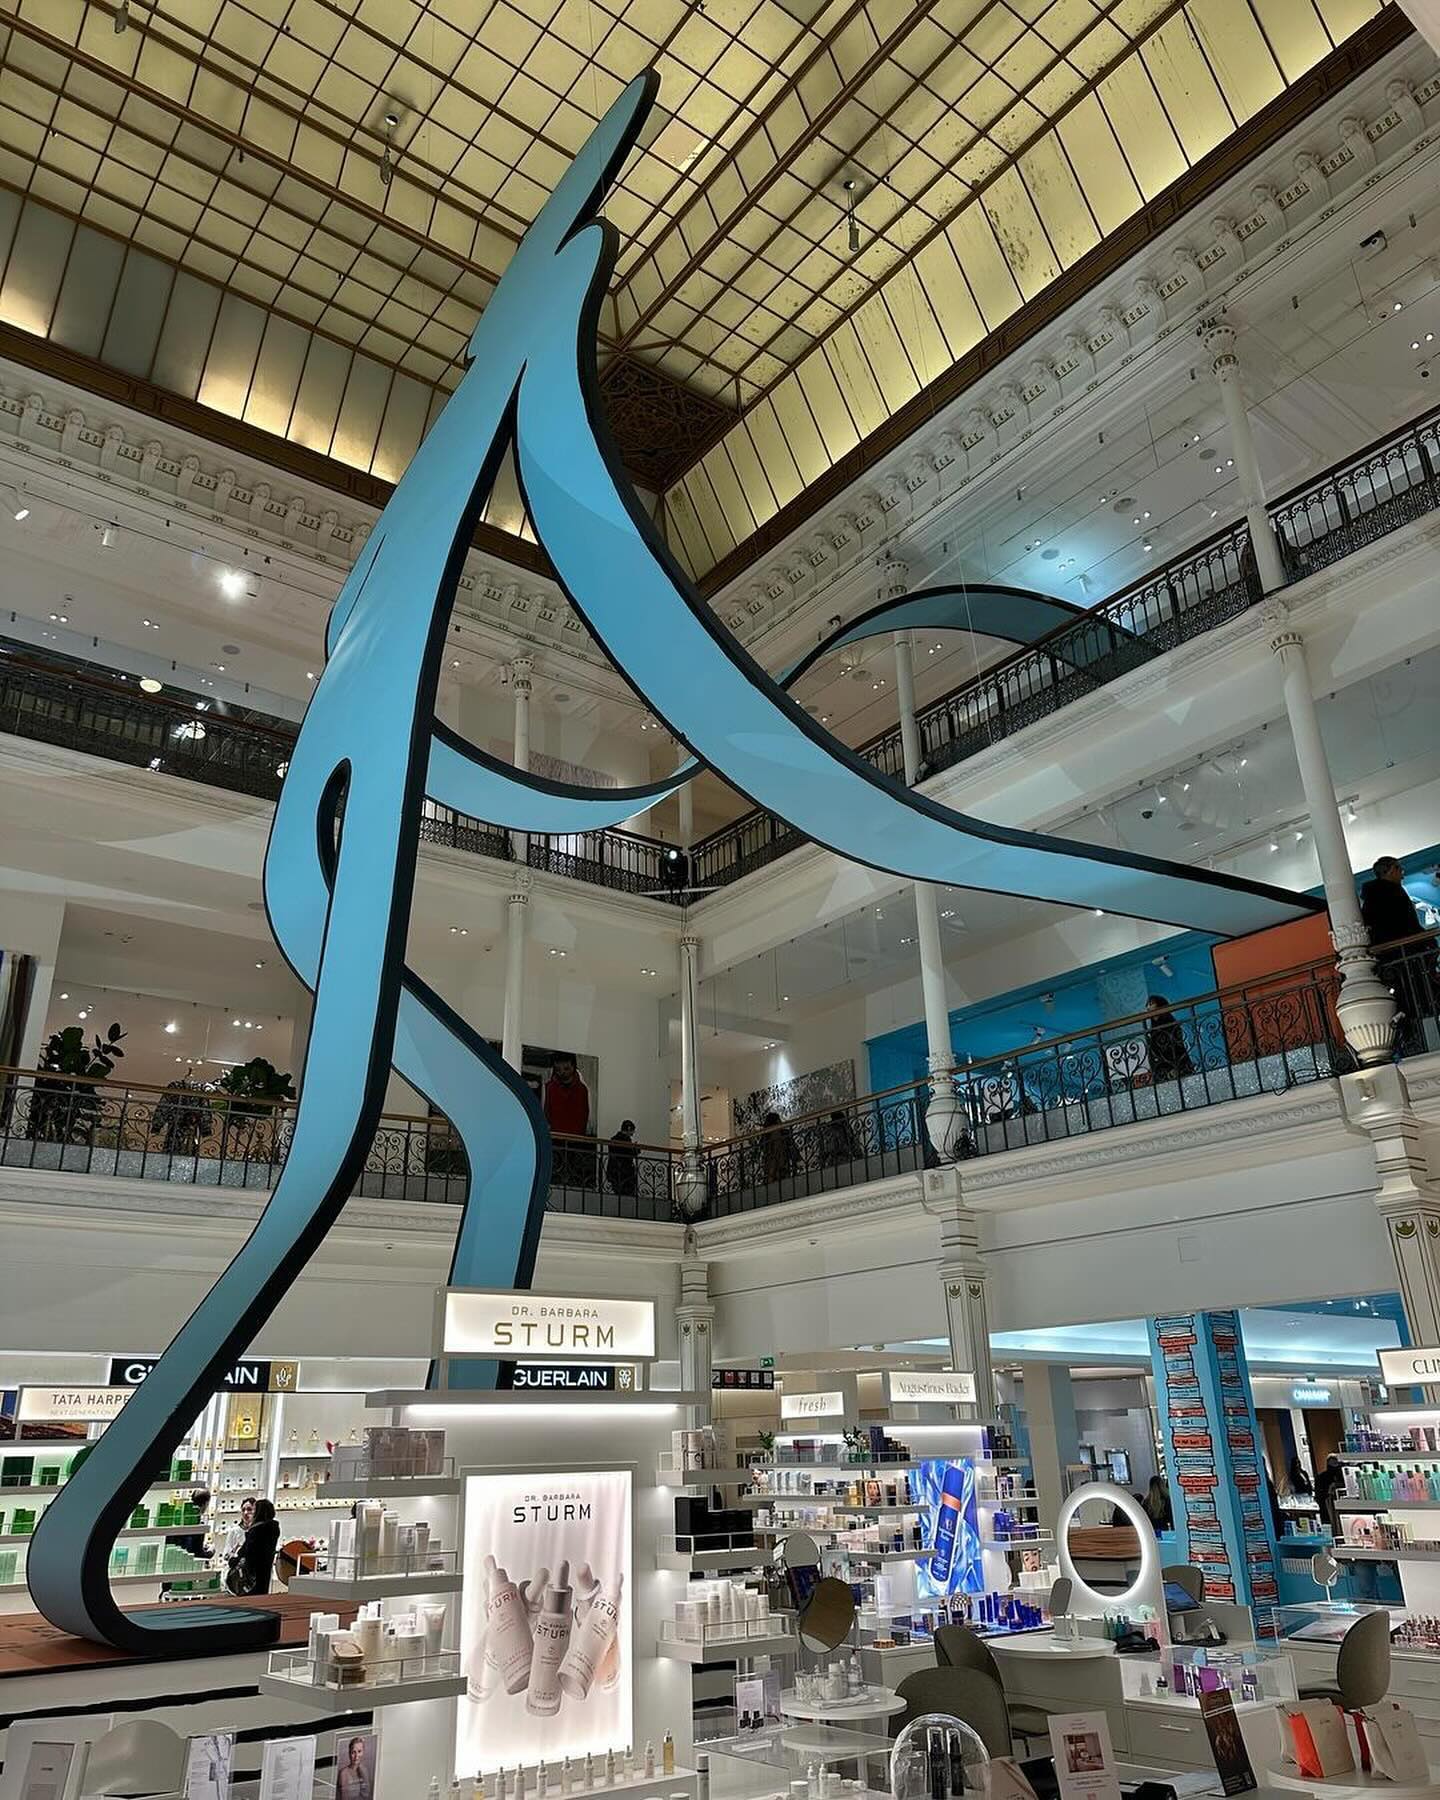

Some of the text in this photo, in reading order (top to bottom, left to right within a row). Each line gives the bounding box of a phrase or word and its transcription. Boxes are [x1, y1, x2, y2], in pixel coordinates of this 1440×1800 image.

[511, 1306, 599, 1318] DR. BARBARA
[493, 1322, 614, 1348] STURM
[513, 1369, 608, 1387] GUERLAIN
[51, 1393, 83, 1406] TATA
[798, 1397, 827, 1413] fresh
[513, 1503, 592, 1523] STURM
